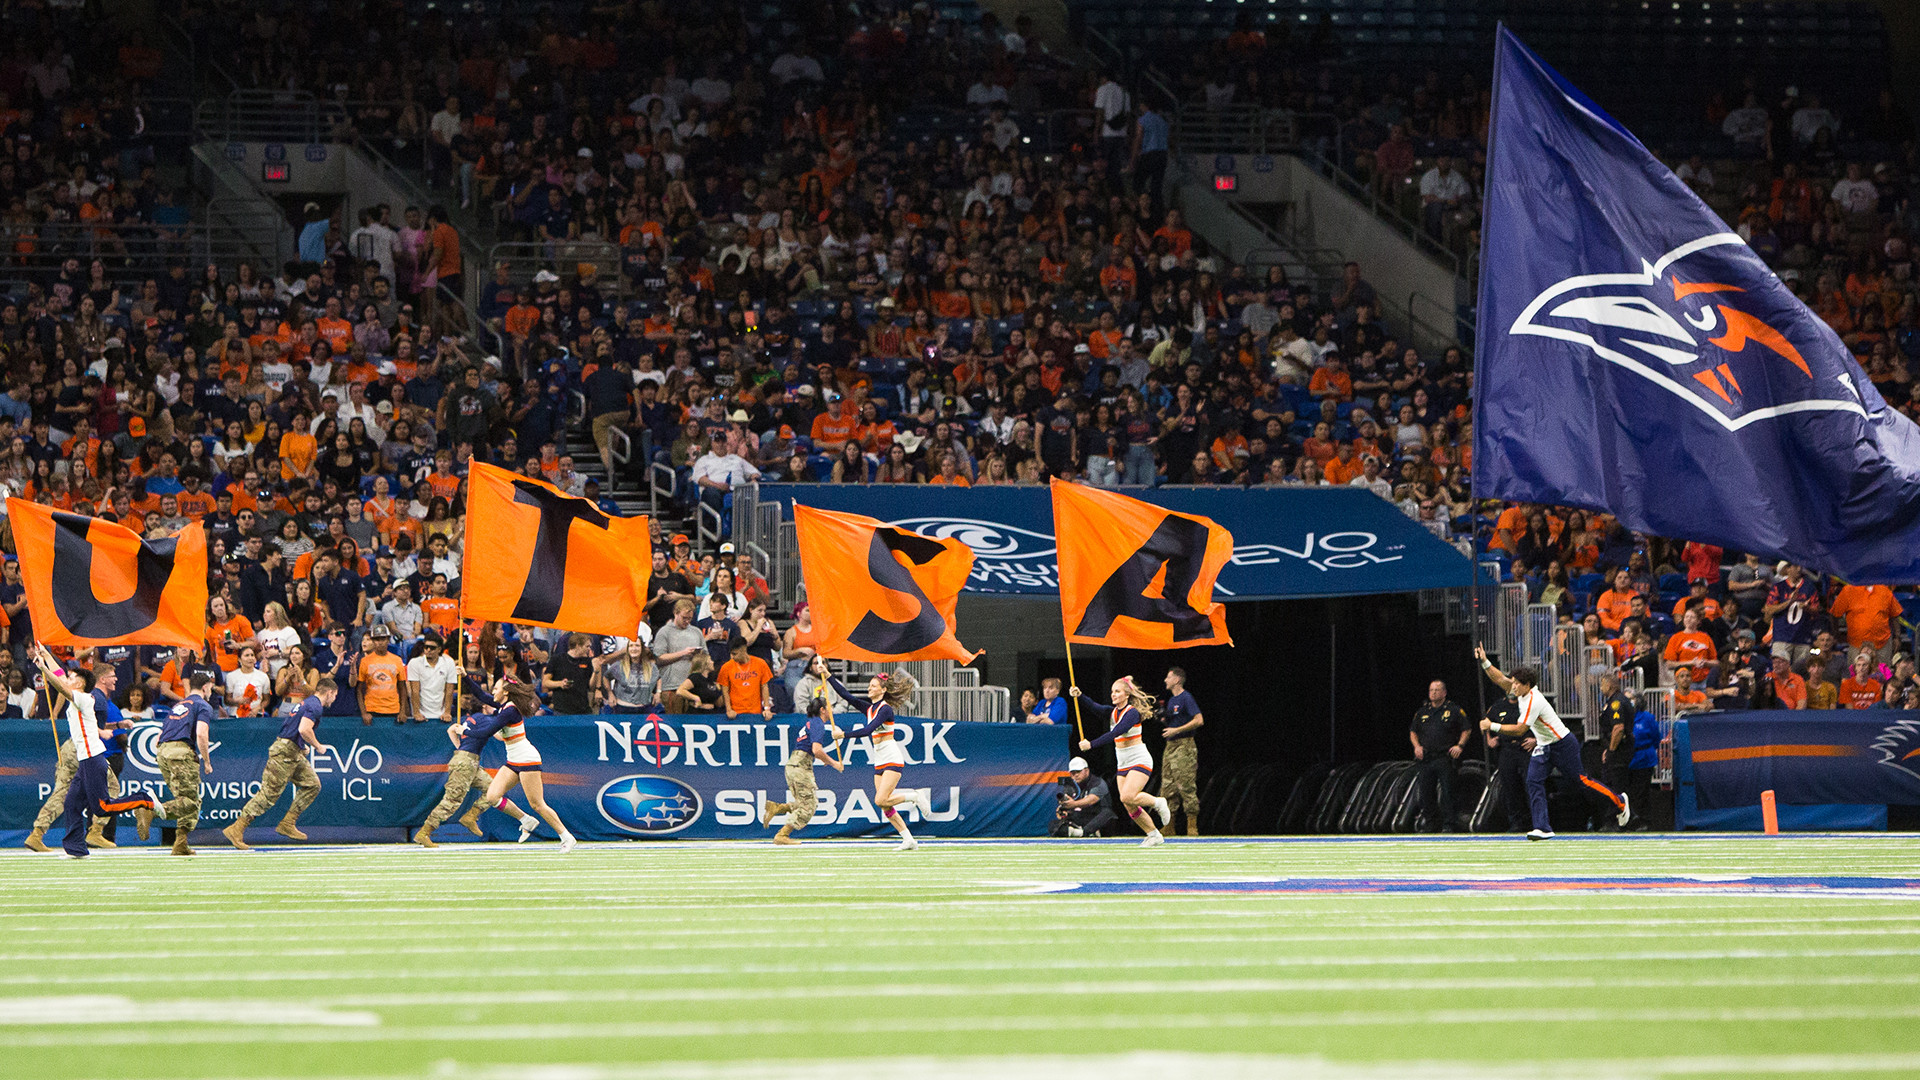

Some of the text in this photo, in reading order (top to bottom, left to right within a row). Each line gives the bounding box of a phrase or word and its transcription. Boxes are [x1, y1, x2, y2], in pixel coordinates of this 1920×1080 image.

[510, 479, 610, 624] T
[51, 512, 180, 639] U
[846, 527, 948, 655] S
[1073, 514, 1215, 643] A
[1787, 601, 1804, 625] 0
[311, 738, 383, 774] EVO
[594, 720, 791, 767] NORTH
[342, 778, 382, 801] ICL
[714, 786, 961, 826] SUBARU
